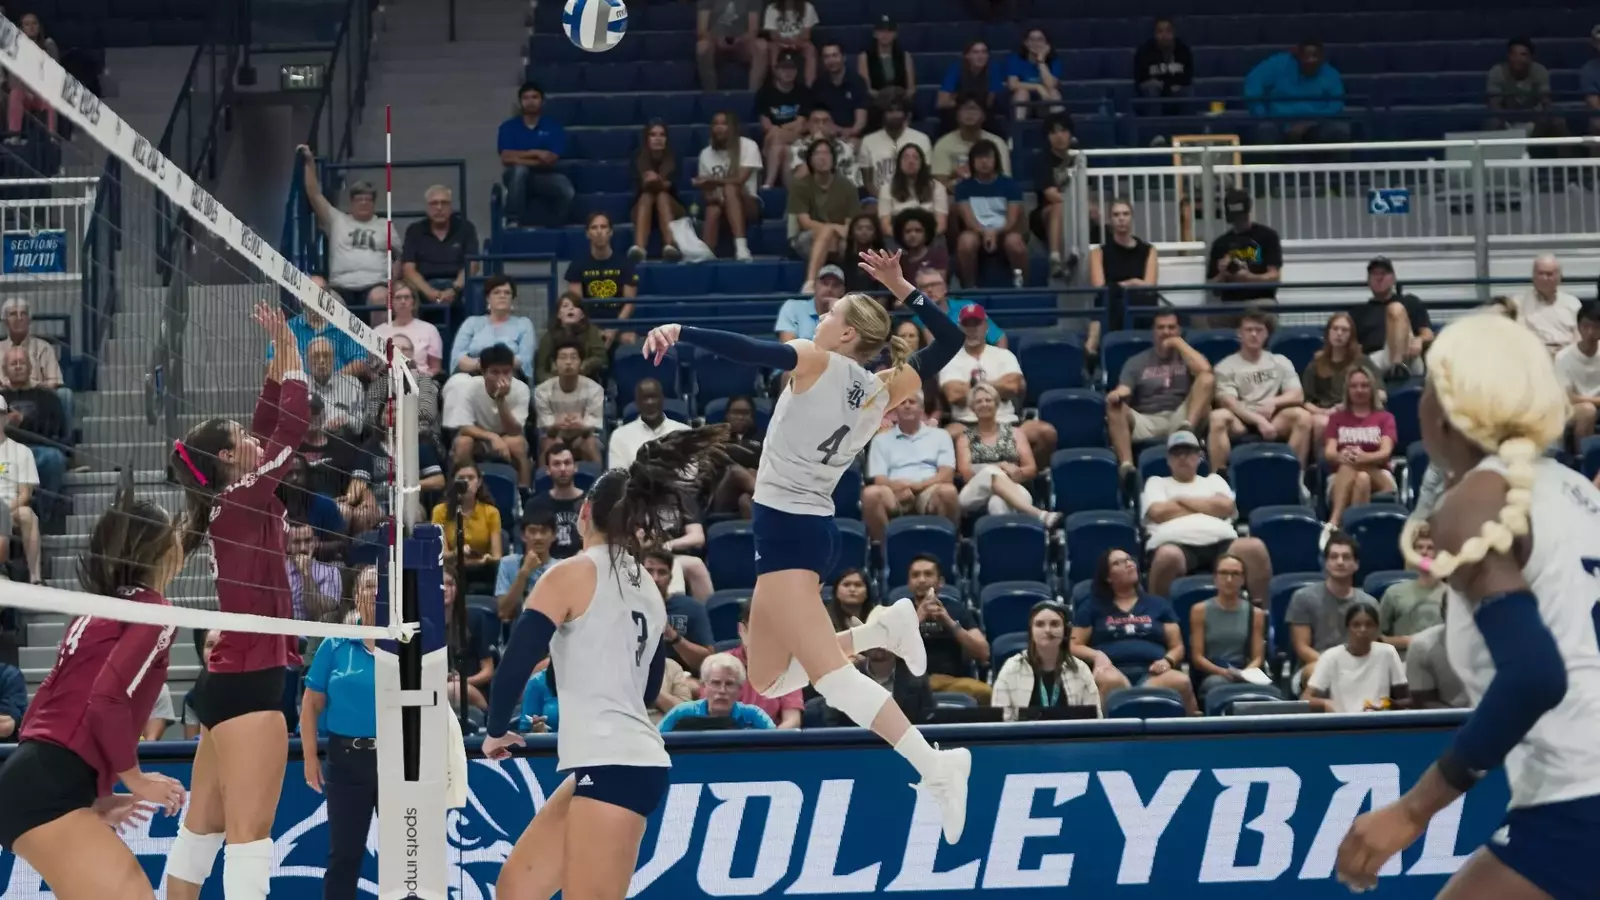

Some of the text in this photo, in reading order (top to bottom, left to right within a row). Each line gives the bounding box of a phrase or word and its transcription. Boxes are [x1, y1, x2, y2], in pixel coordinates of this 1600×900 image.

[11, 239, 58, 250] SECTIONS
[14, 252, 55, 267] 110/111
[817, 424, 851, 465] 4
[631, 610, 648, 667] 3
[404, 807, 419, 857] sports
[625, 762, 1475, 899] VOLLEYBAL
